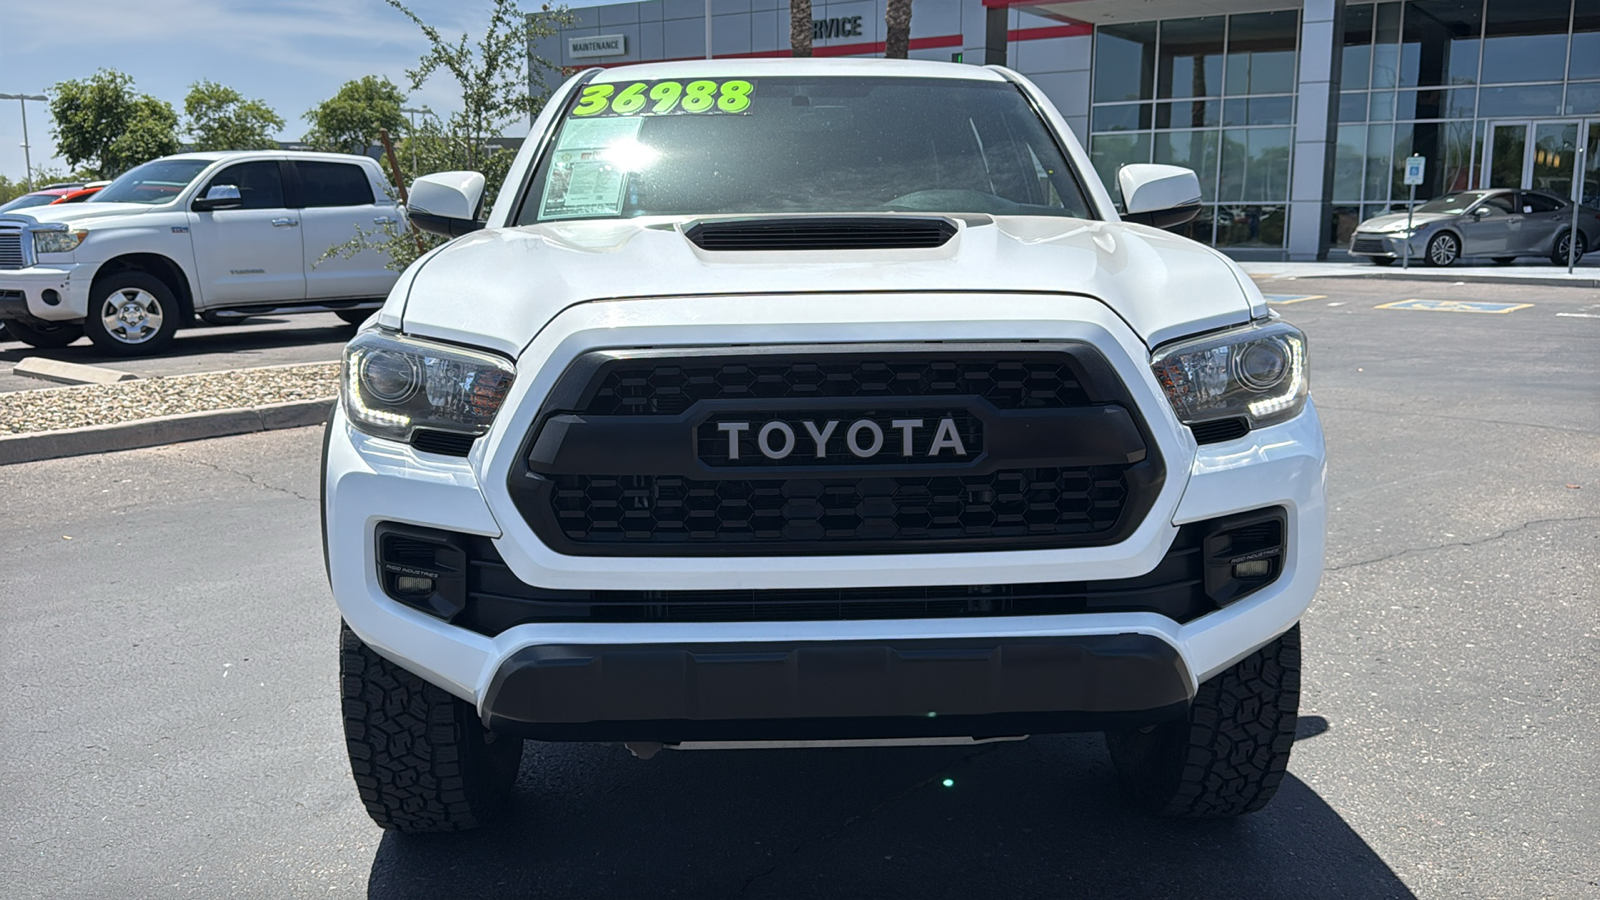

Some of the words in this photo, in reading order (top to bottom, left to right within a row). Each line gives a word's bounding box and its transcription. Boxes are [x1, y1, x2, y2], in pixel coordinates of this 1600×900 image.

[812, 15, 862, 39] RVICE
[572, 40, 619, 52] MAINTENANCE
[572, 80, 754, 116] 36988
[717, 418, 967, 460] TOYOTA
[402, 567, 439, 578] INDUSTRIES
